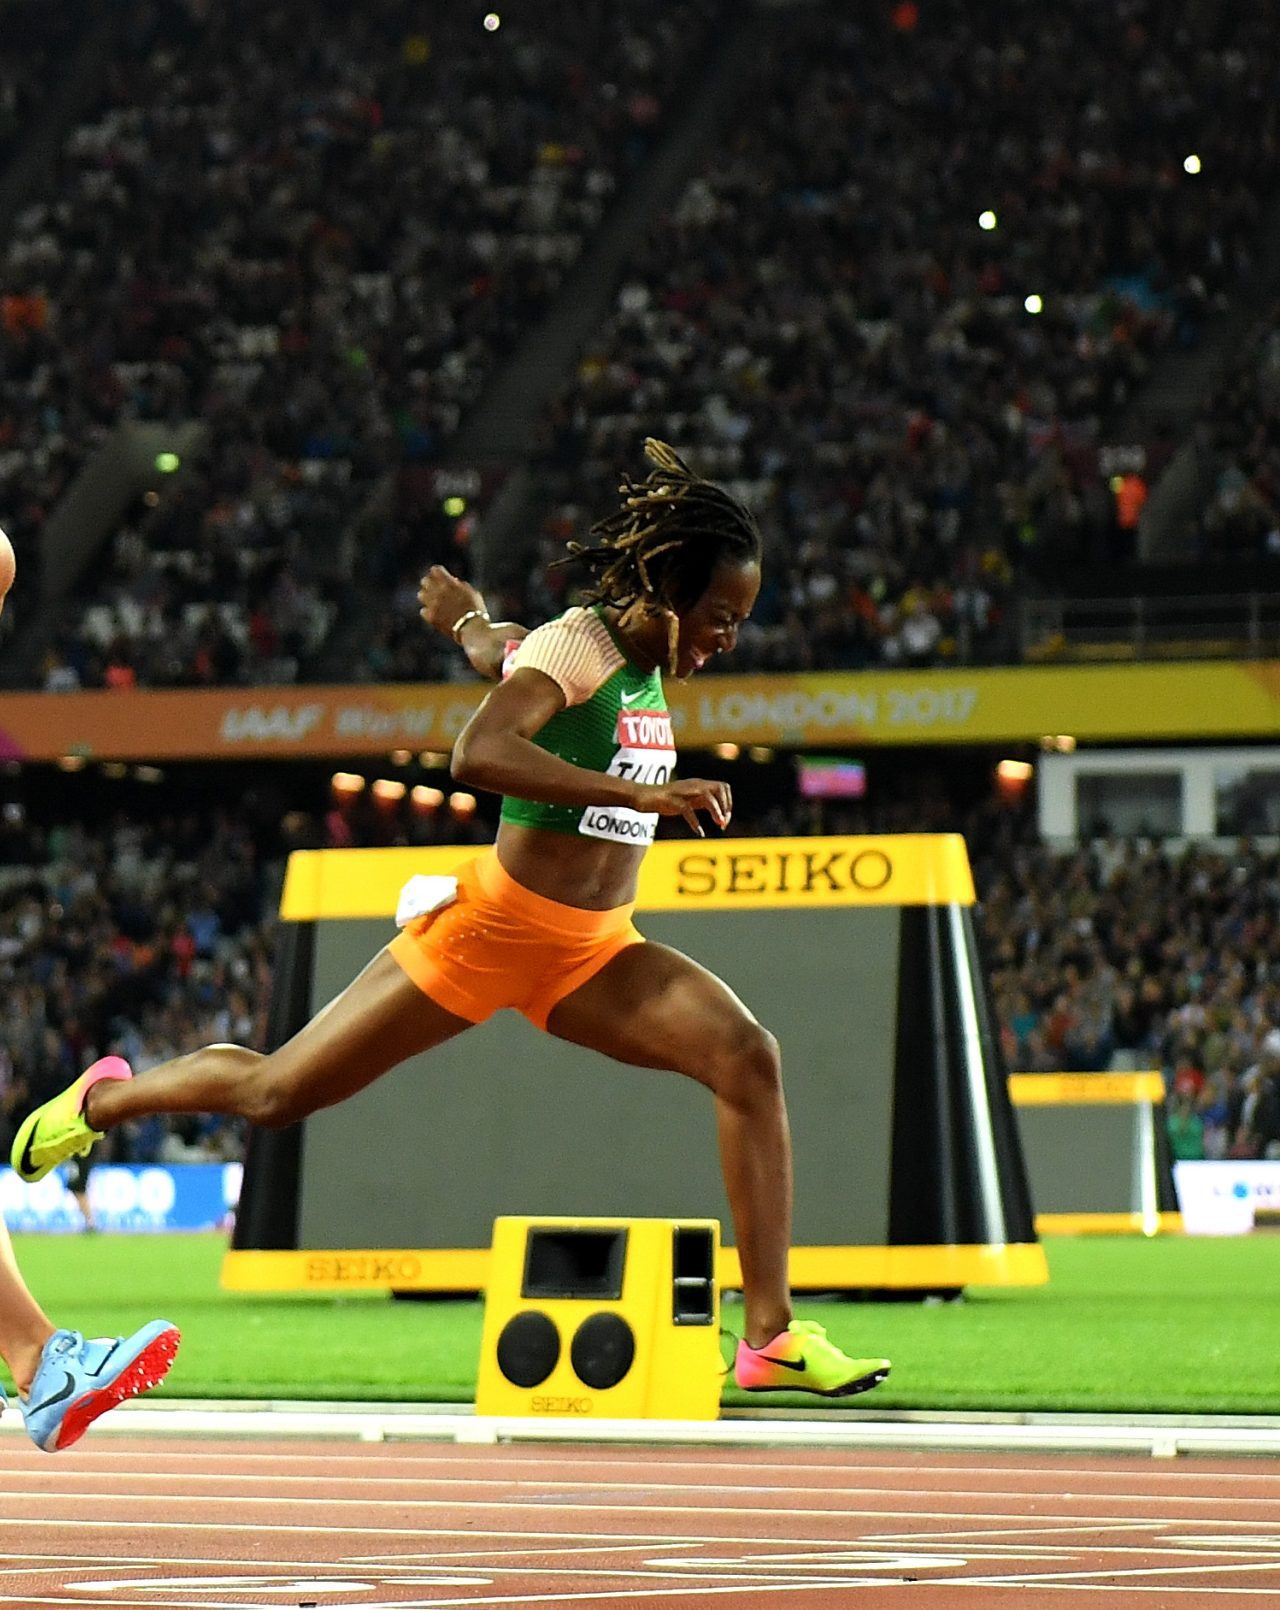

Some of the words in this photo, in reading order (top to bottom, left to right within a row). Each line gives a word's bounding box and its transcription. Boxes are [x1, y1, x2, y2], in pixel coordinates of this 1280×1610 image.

[699, 688, 878, 731] LONDON
[886, 687, 979, 728] 2017
[586, 811, 648, 838] LONDON
[677, 849, 894, 897] SEIKO
[306, 1255, 422, 1282] SEIKO
[530, 1395, 594, 1414] SEIKO
